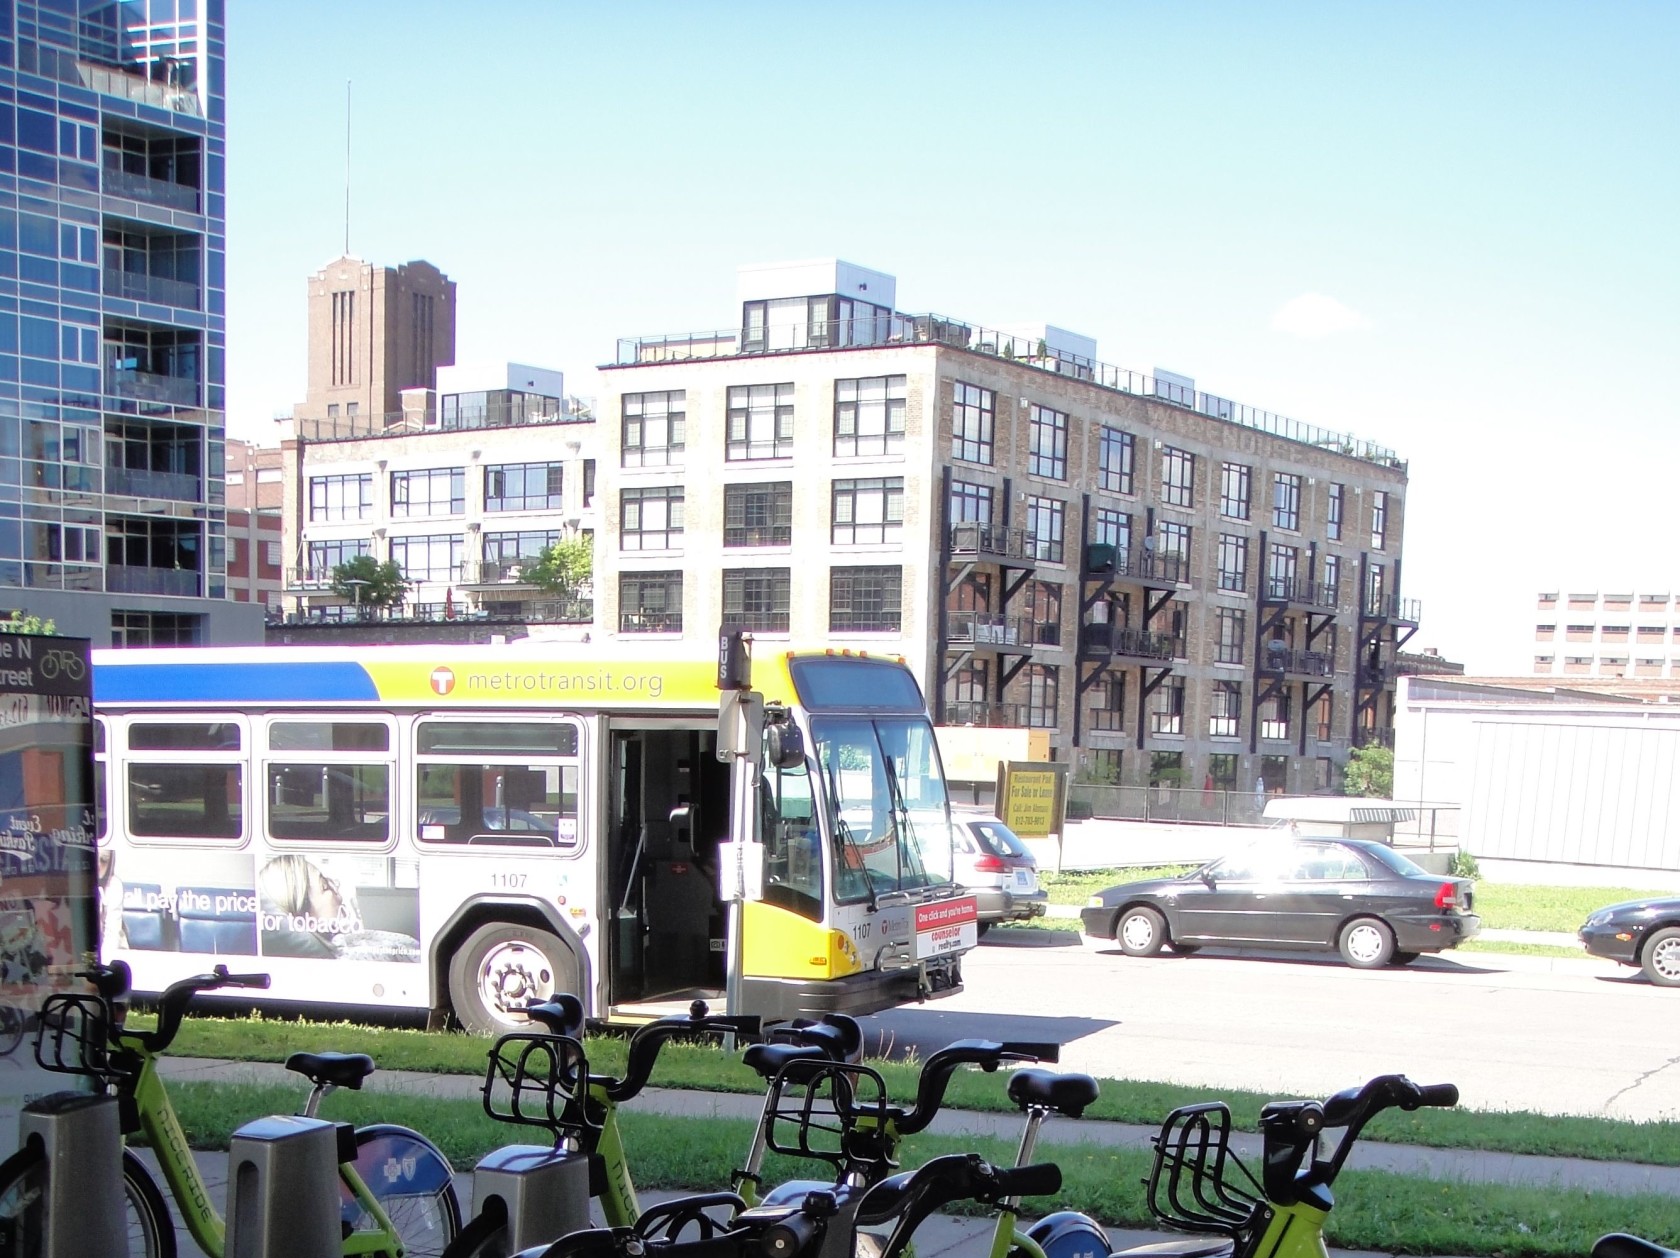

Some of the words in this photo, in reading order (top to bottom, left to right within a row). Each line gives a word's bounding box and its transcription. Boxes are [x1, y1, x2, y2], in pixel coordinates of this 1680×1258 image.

[18, 638, 31, 659] N
[720, 636, 729, 679] BUS
[468, 669, 662, 698] metrotransit.org
[491, 873, 528, 888] 1107
[147, 892, 178, 921] pay
[180, 889, 211, 911] the
[216, 894, 258, 916] price
[260, 912, 285, 931] for
[918, 912, 929, 923] One
[929, 909, 939, 921] click
[939, 908, 948, 919] and
[853, 922, 871, 941] 1107
[931, 926, 961, 942] counselor
